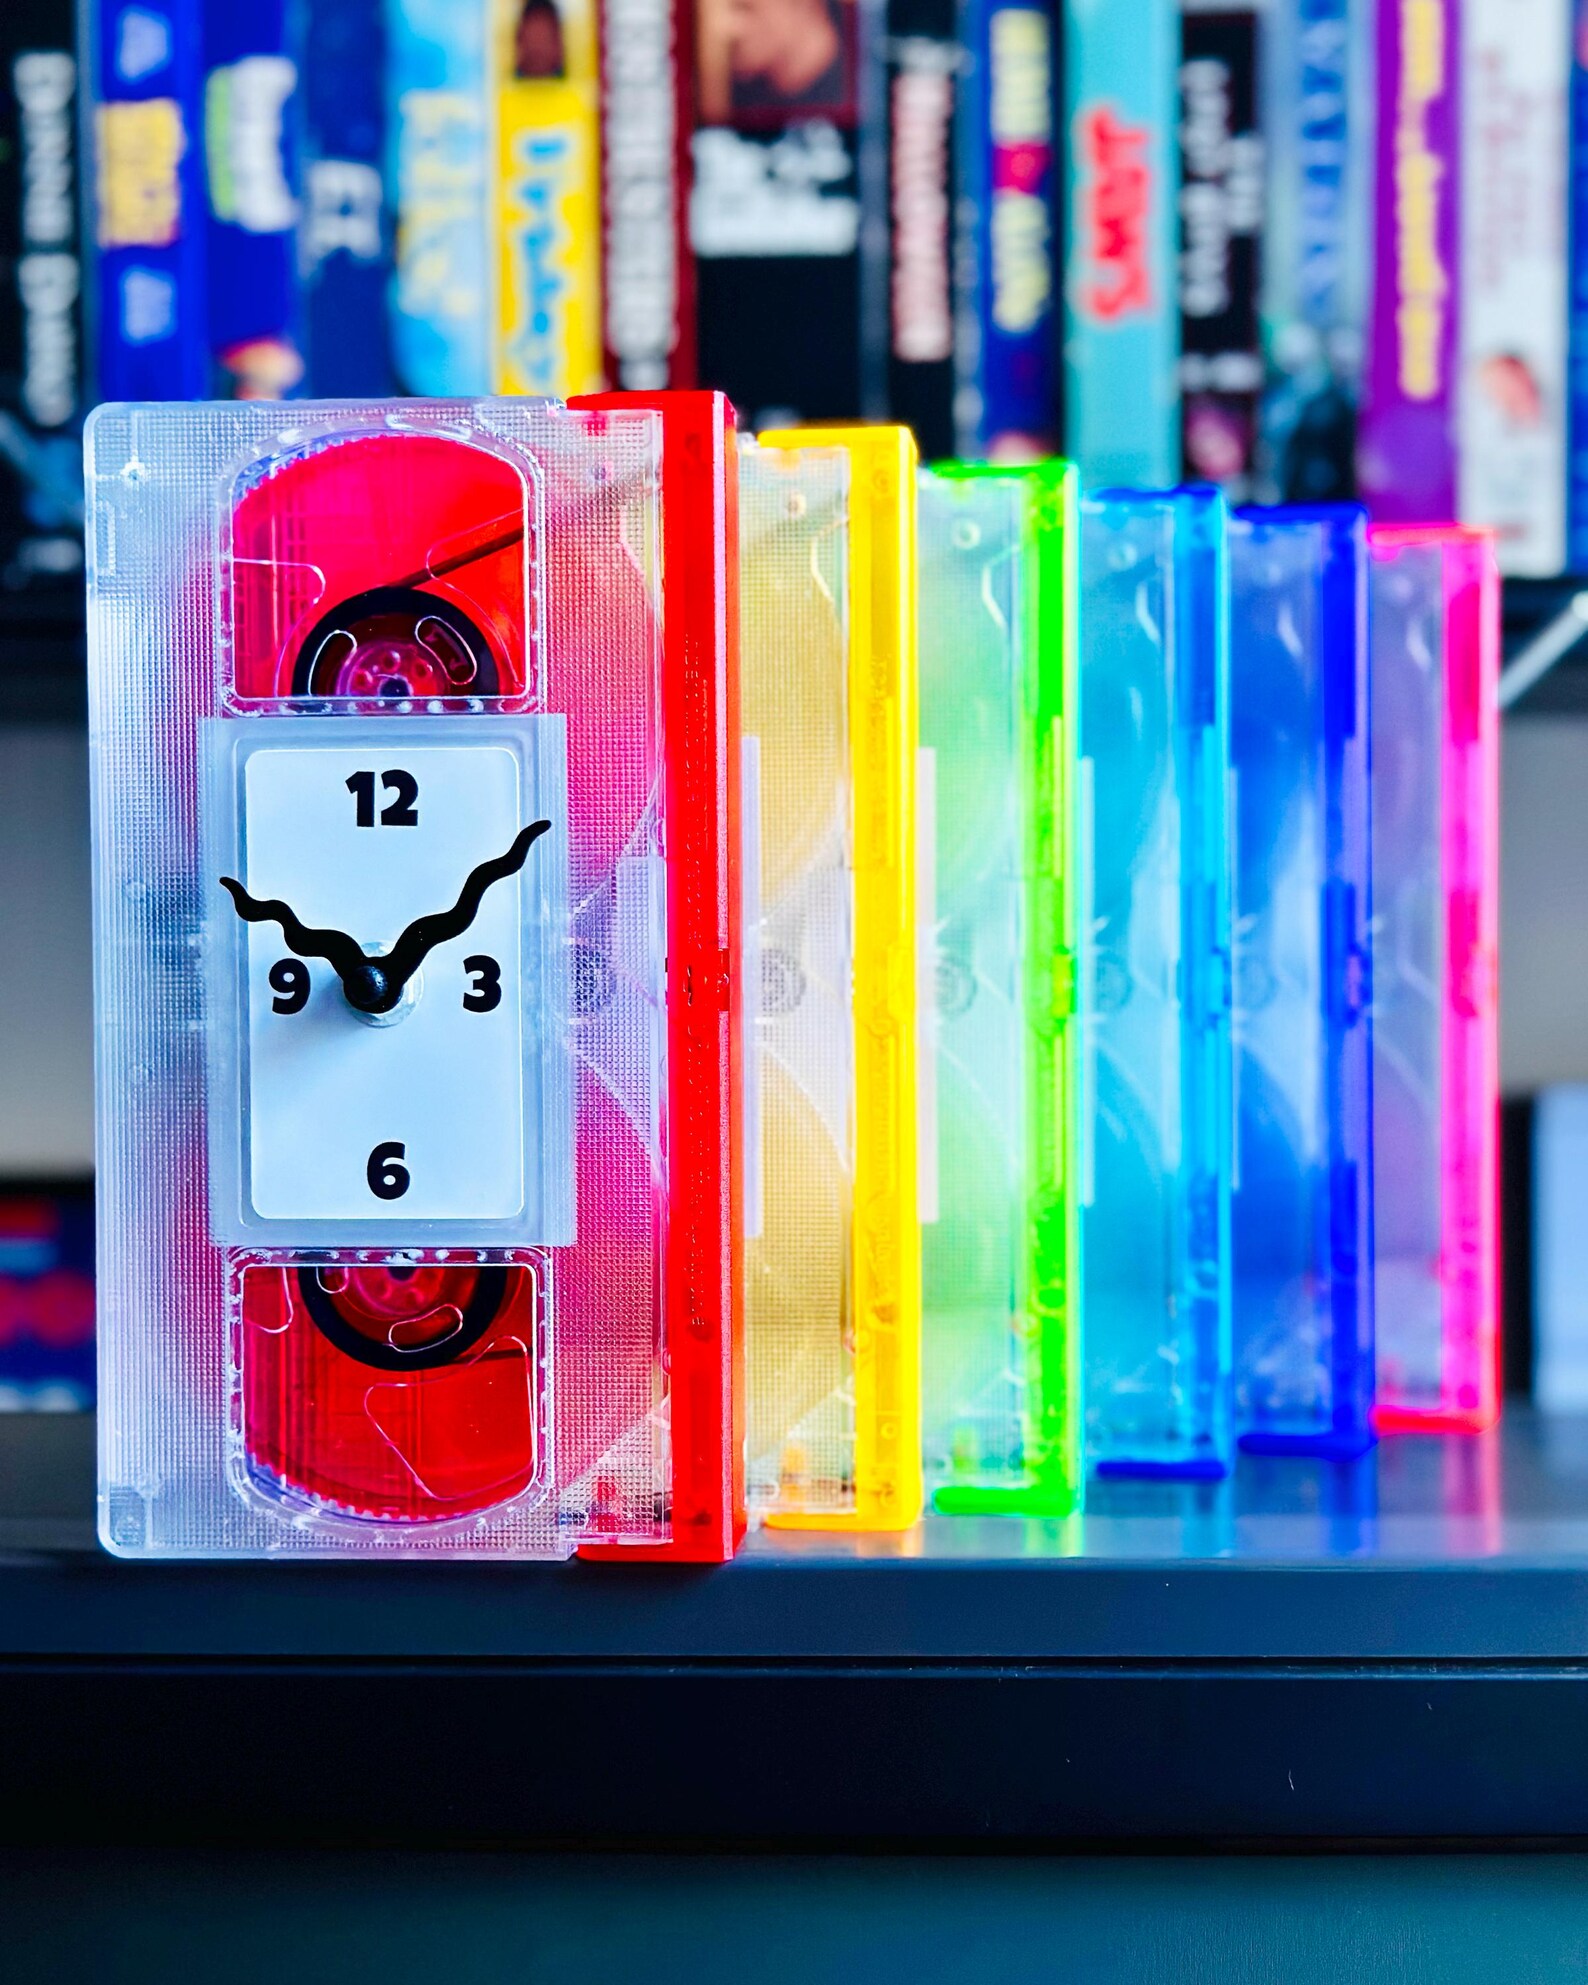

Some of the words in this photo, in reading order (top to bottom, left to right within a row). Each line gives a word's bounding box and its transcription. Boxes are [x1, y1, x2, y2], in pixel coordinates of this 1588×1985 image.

[345, 769, 418, 828] 12
[268, 958, 311, 1014] 9
[462, 955, 502, 1013] 3
[366, 1141, 410, 1200] 6
